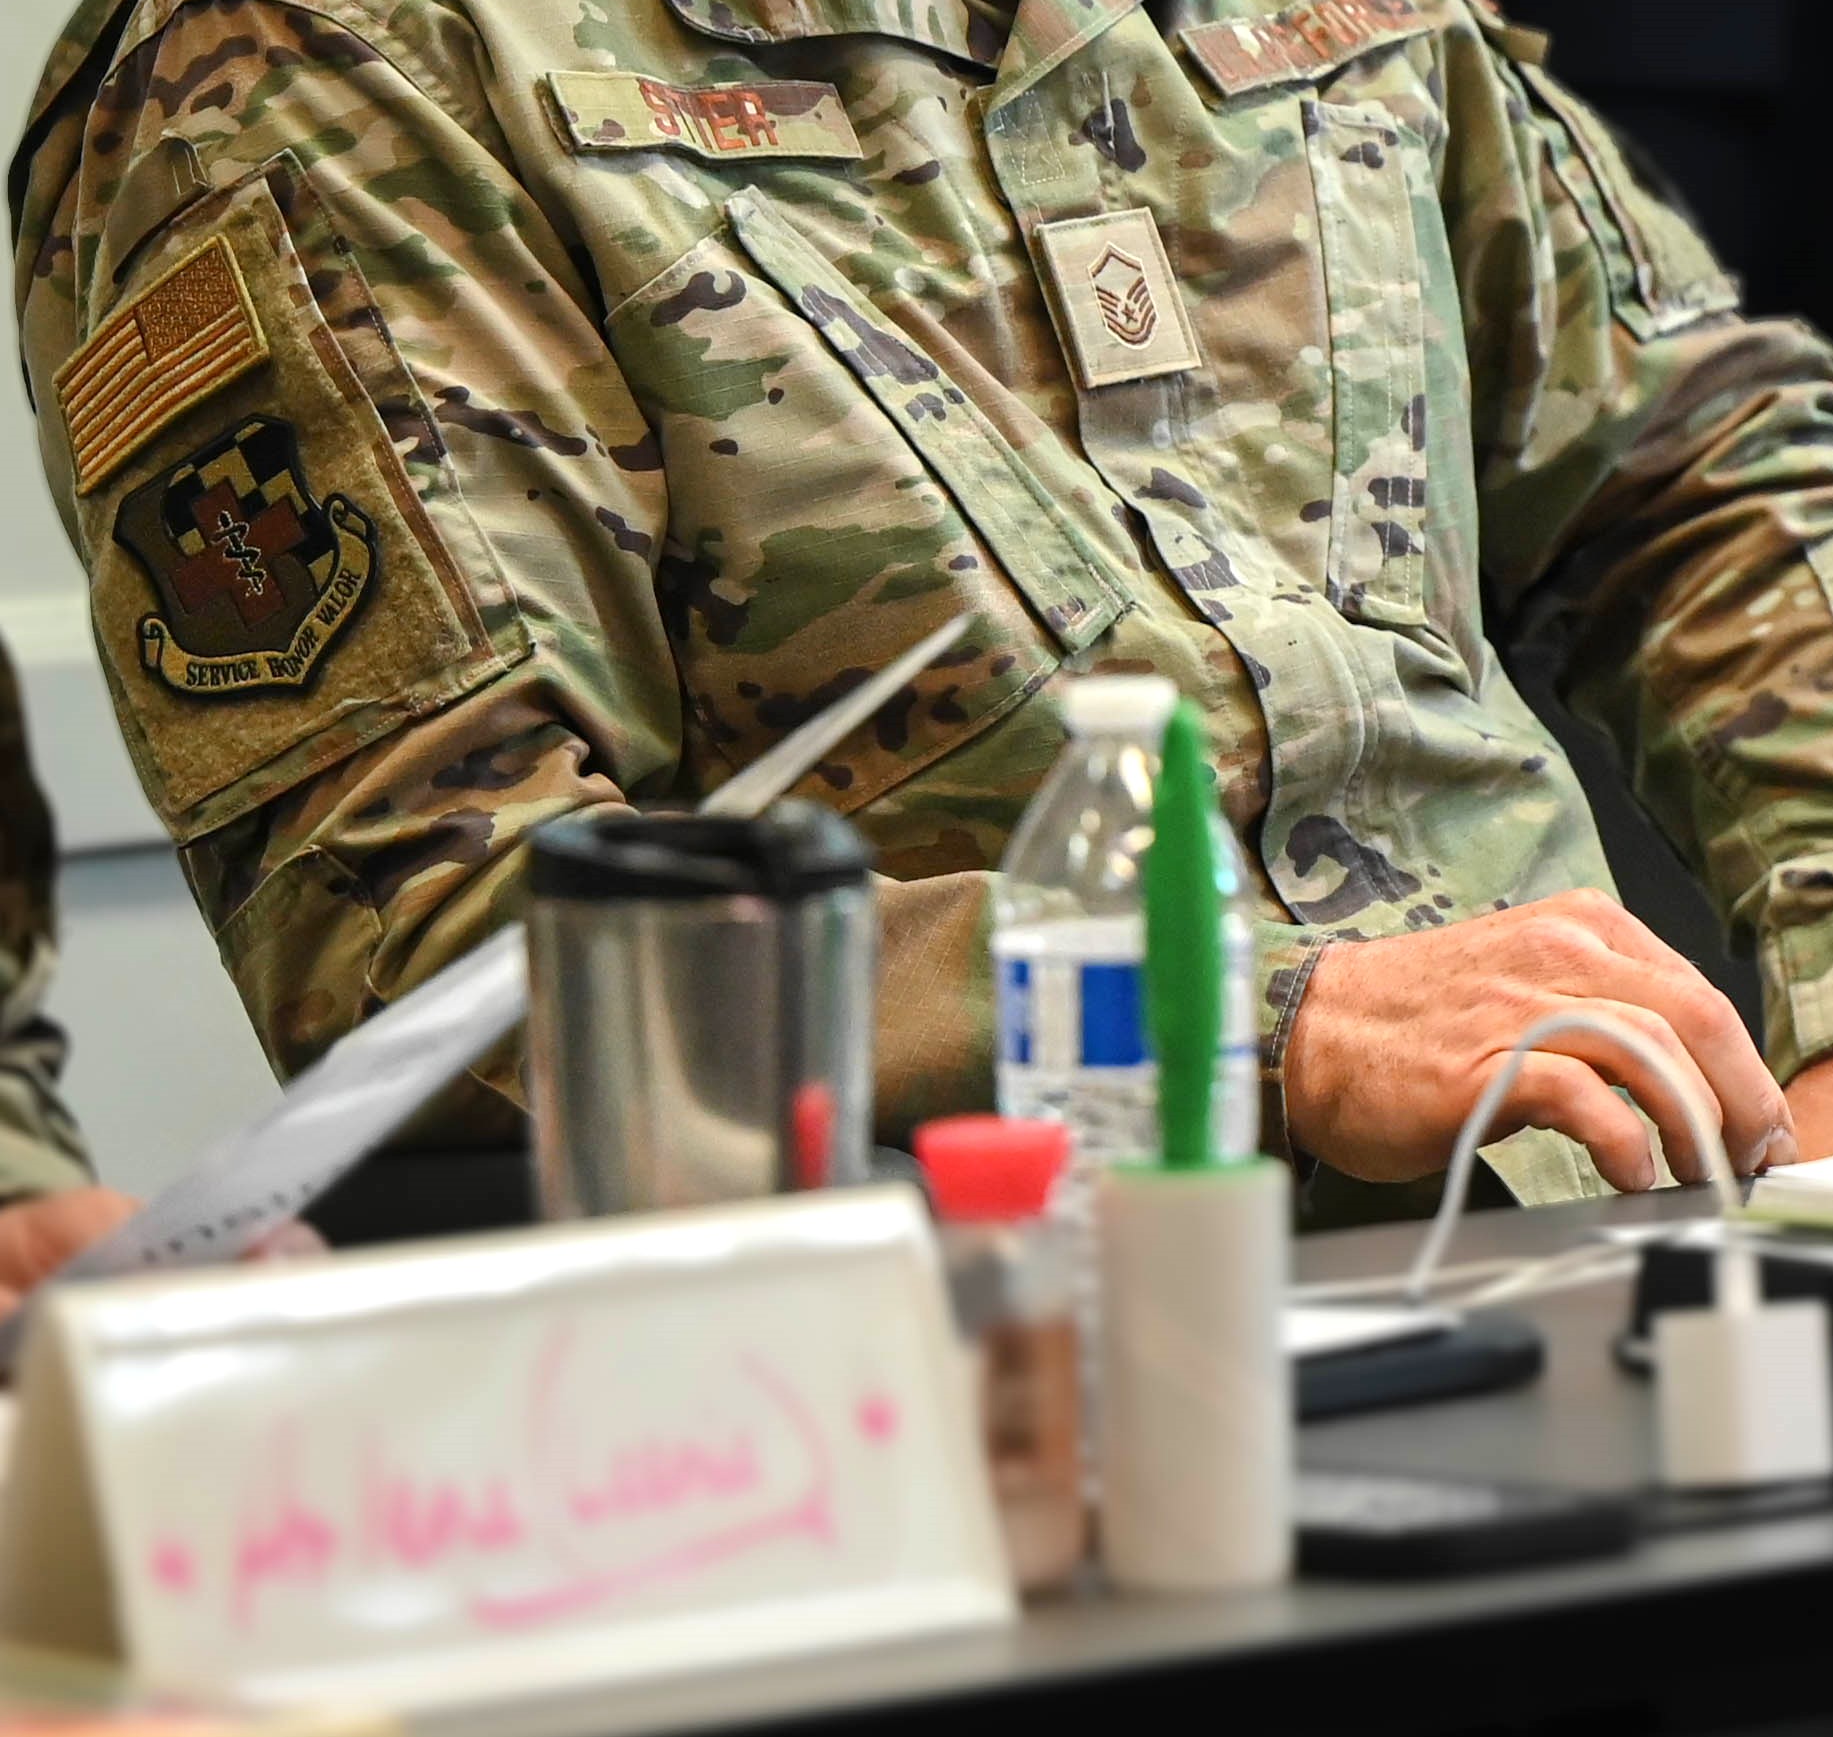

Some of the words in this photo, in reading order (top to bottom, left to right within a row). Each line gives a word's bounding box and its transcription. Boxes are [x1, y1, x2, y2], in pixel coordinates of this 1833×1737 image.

[185, 660, 261, 688] SERVICE
[266, 625, 319, 680] HONOR
[316, 567, 362, 627] VALOR
